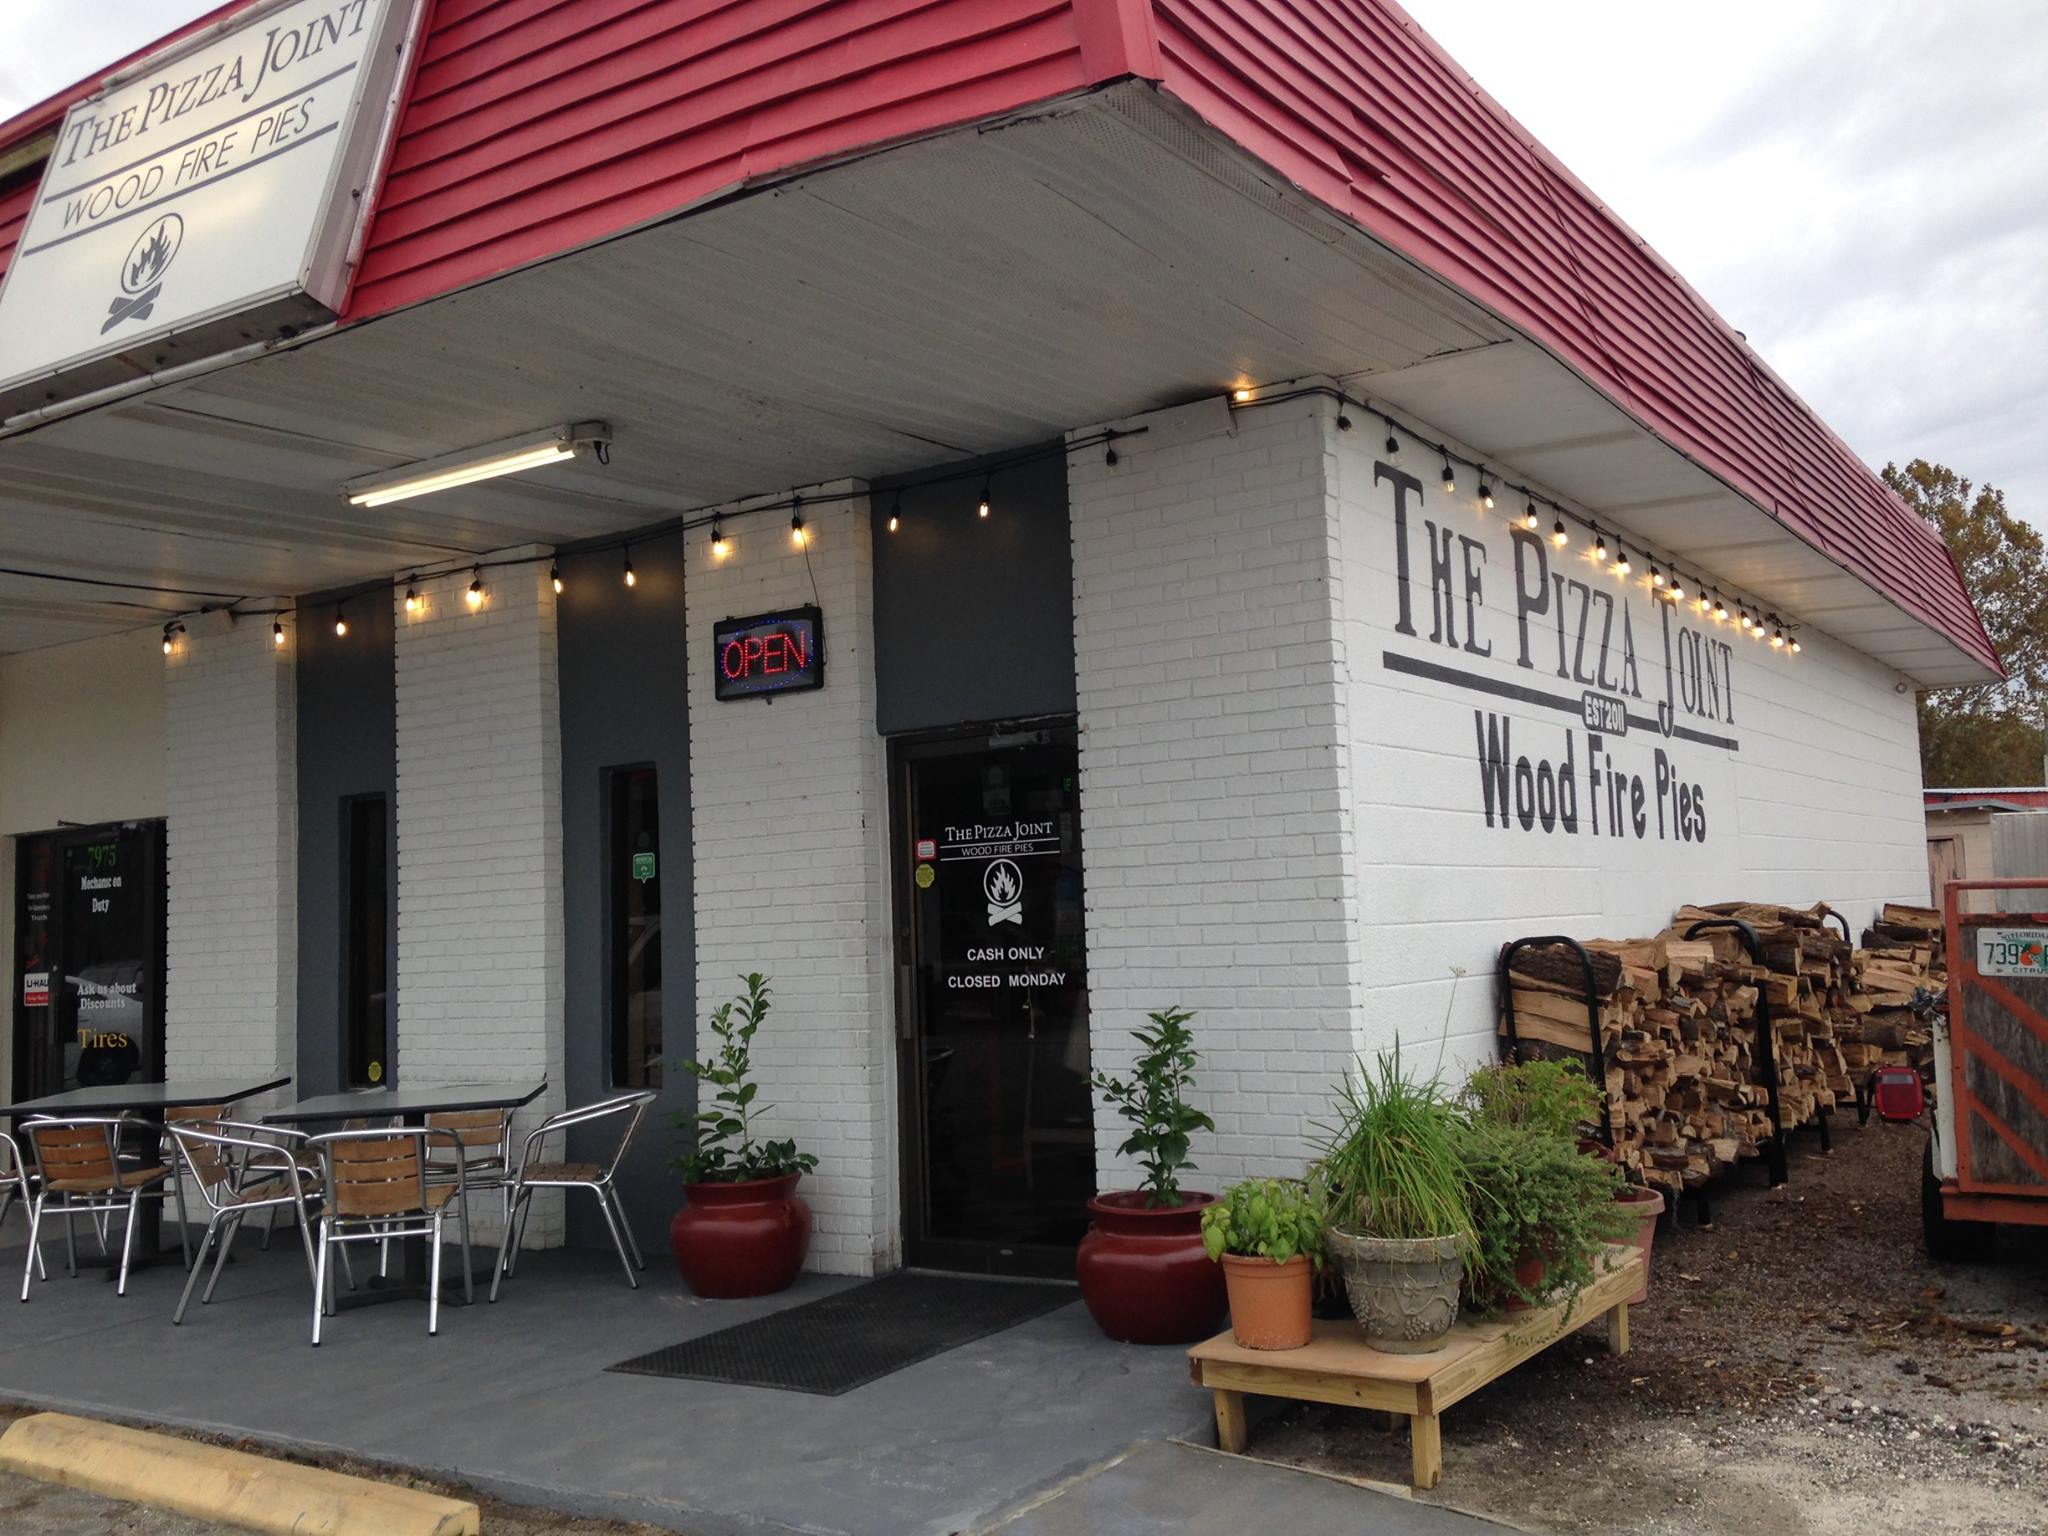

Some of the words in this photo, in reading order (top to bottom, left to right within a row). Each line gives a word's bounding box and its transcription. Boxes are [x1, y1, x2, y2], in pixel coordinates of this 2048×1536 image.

[61, 105, 138, 168] THE
[134, 54, 244, 137] PIZZA
[241, 0, 373, 103] JOINT
[63, 165, 164, 229] WOOD
[174, 131, 238, 186] FIRE
[250, 97, 314, 154] PIES
[1373, 460, 1492, 658] THE
[1509, 522, 1642, 699] PIZZA
[1652, 587, 1735, 738] JOINT
[723, 630, 807, 678] OPEN
[1475, 709, 1578, 834] Wood
[1588, 733, 1646, 839] Fire
[1654, 748, 1706, 843] Pies
[945, 826, 973, 841] THE
[974, 824, 1012, 839] PIZZA
[1013, 821, 1053, 841] JOINT
[962, 847, 992, 856] WOOD
[994, 845, 1012, 854] FIRE
[1015, 843, 1034, 852] PIES
[112, 875, 122, 888] on
[92, 898, 110, 913] Duty
[967, 948, 1004, 961] CASH
[1008, 947, 1045, 960] ONLY
[1984, 943, 2019, 965] 739
[77, 983, 95, 996] Ask
[97, 984, 108, 995] us
[109, 982, 137, 995] about
[948, 975, 1000, 988] CLOSED
[1008, 973, 1066, 987] MONDAY
[80, 997, 126, 1010] Discounts
[77, 1028, 129, 1049] Tires
